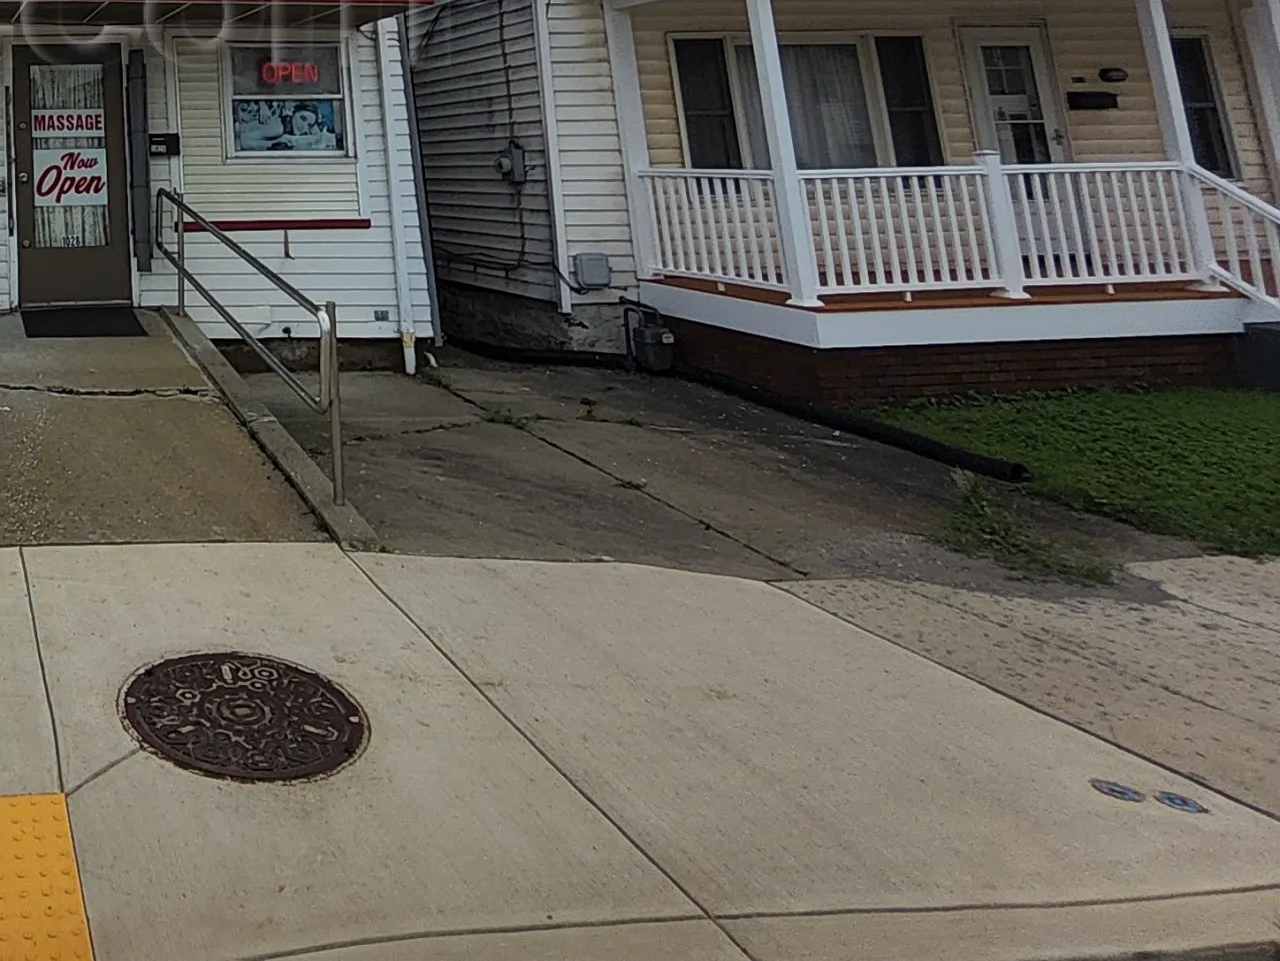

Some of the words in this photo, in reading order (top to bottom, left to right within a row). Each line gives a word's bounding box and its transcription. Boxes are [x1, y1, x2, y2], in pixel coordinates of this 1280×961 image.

[260, 60, 319, 84] OPEN
[33, 113, 103, 132] MASSAGE
[60, 151, 100, 171] Now
[36, 164, 107, 204] Open
